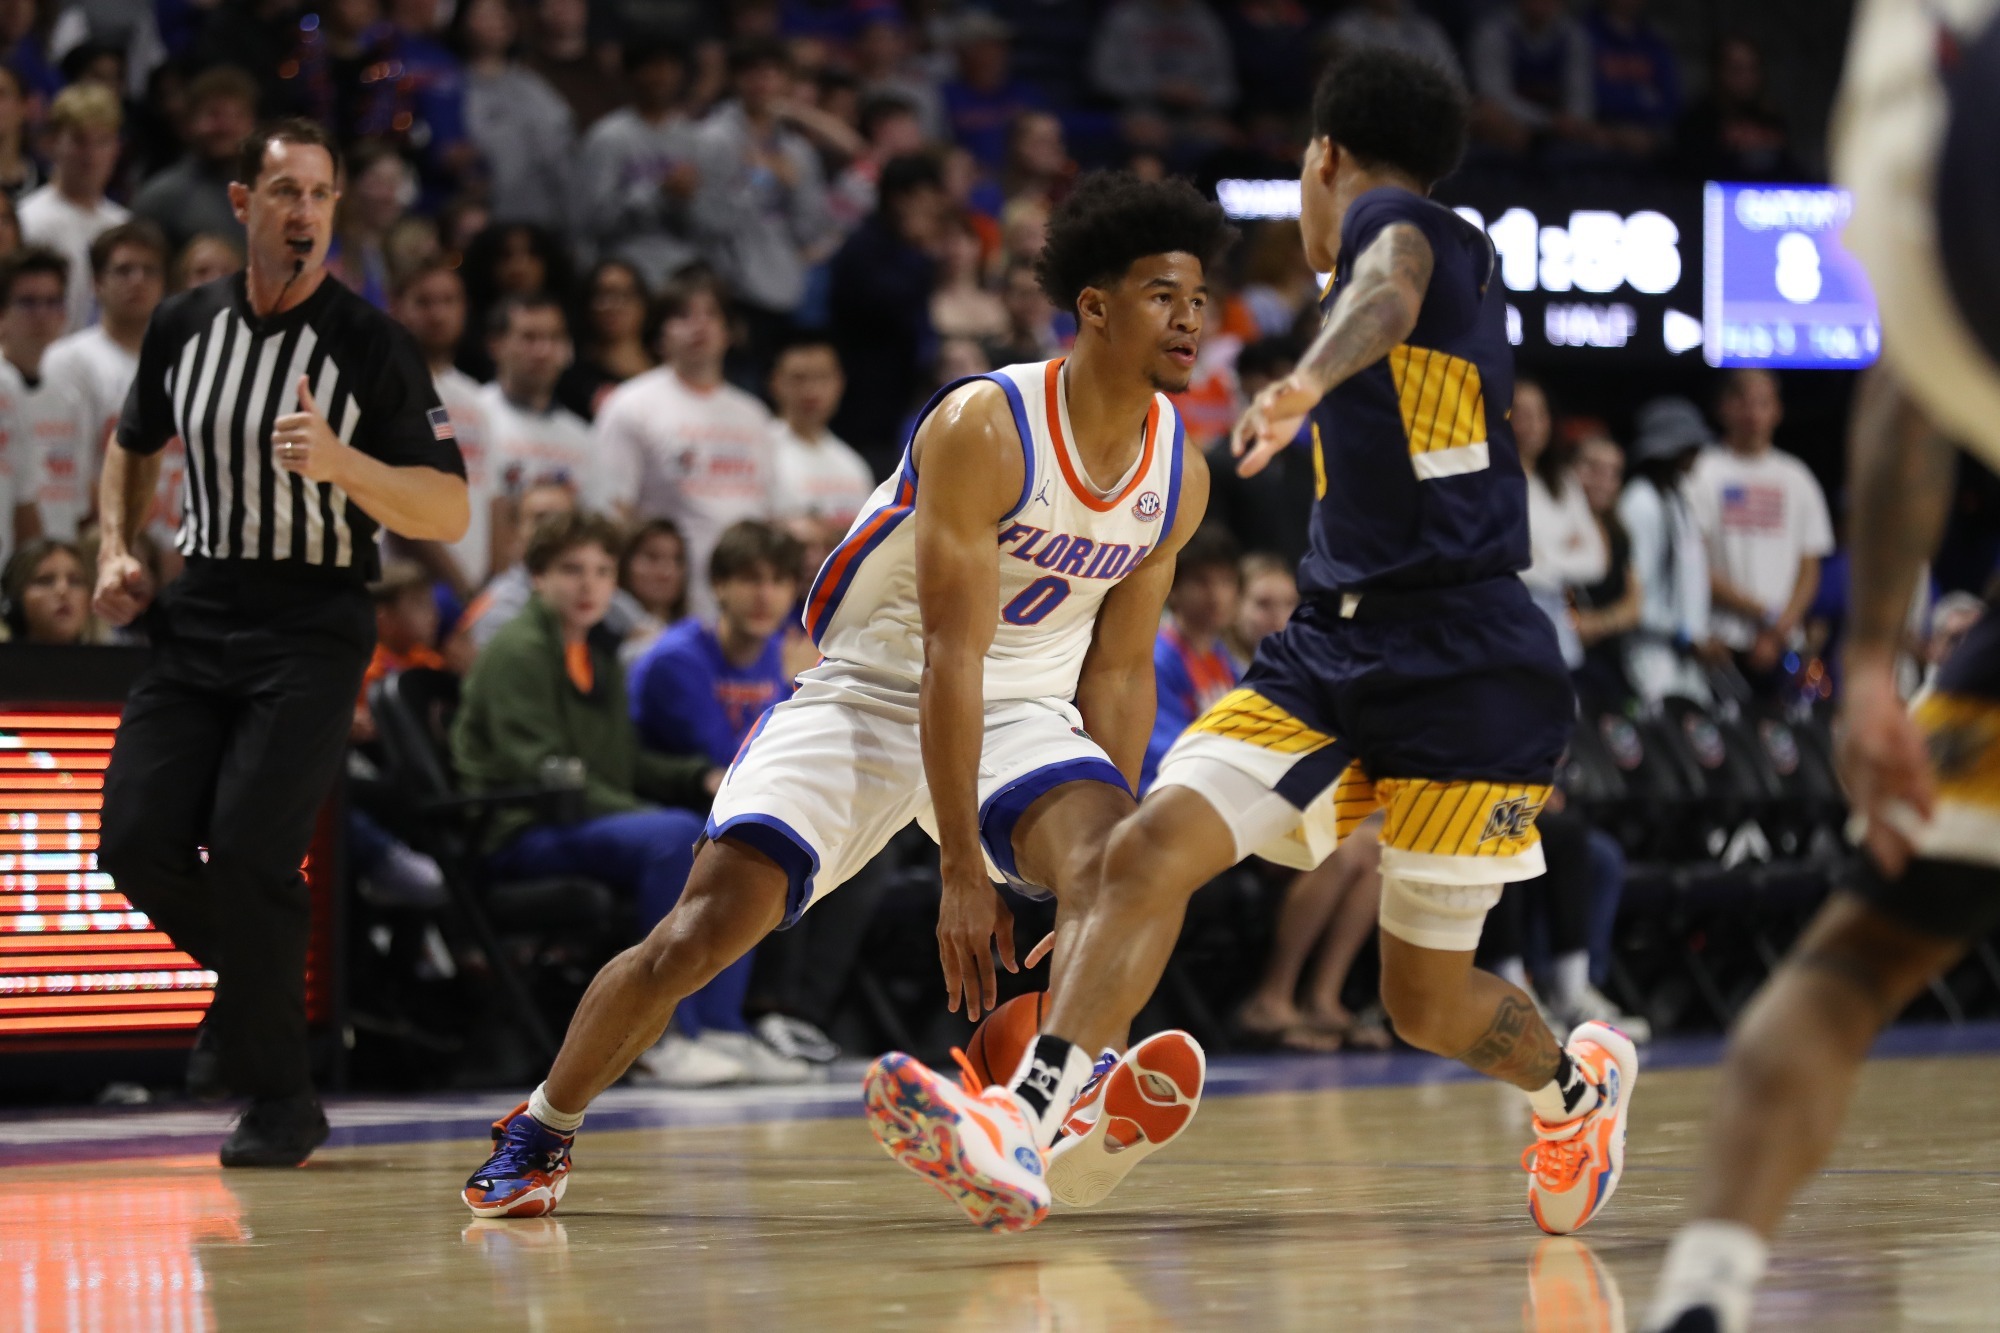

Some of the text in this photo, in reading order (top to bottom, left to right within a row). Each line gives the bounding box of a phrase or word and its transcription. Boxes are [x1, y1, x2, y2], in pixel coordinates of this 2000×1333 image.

[1452, 207, 1682, 293] 1:56
[1139, 493, 1159, 515] SEC
[998, 520, 1151, 580] FLORIDA
[1001, 575, 1071, 626] 0
